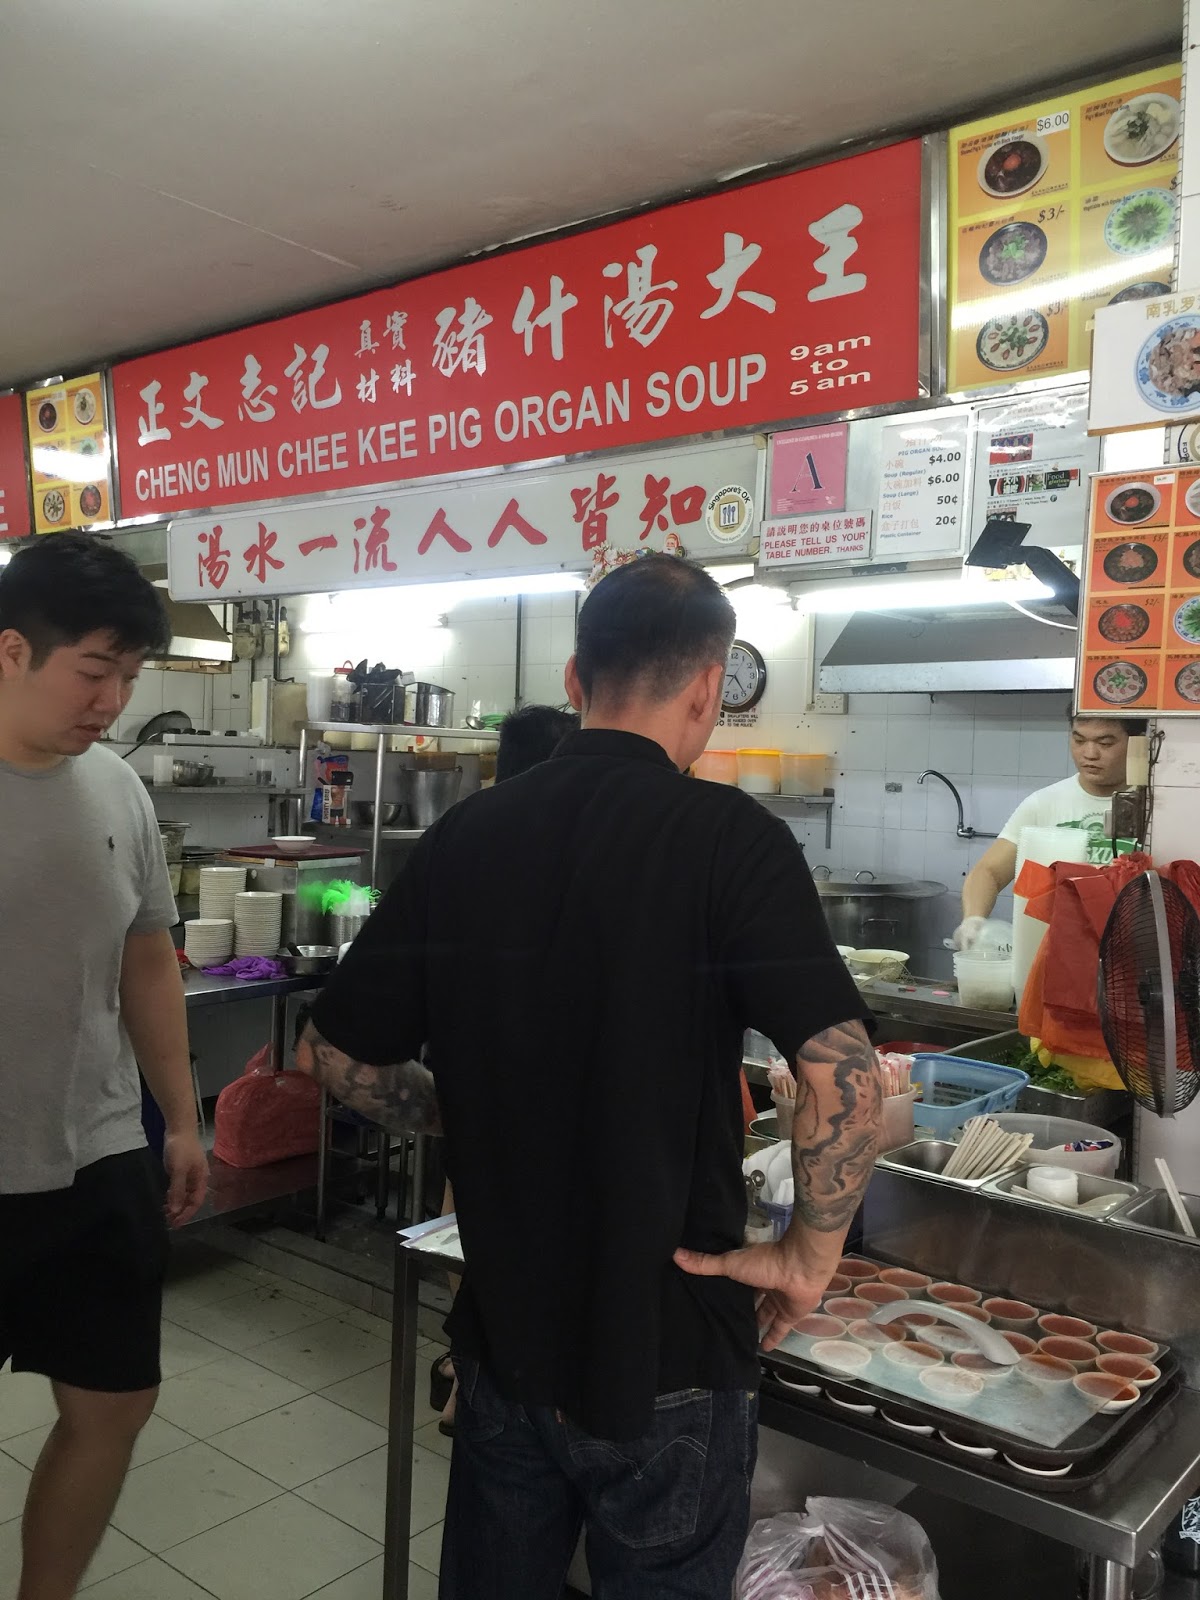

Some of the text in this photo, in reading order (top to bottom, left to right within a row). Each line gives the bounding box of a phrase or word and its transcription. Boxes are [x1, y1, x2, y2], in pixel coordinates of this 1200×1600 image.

[1037, 112, 1069, 132] $6.00
[1145, 295, 1200, 320] 南乳罗
[790, 335, 871, 361] 9am
[810, 358, 849, 375] to
[135, 353, 767, 501] CHENG MUN CHEE KEE PIG ORGAN SOUP
[910, 447, 931, 455] ORGAN
[929, 452, 961, 466] $4.00
[789, 451, 826, 494] A
[899, 469, 926, 477] (Regular)
[928, 473, 960, 486] $6.00
[1047, 472, 1065, 480] Food
[708, 486, 751, 511] Singapore's OK
[898, 490, 919, 498] (Large)
[937, 494, 958, 505] 50¢
[935, 516, 957, 526] 20¢
[764, 532, 866, 550] PLEASE TELL US YOUR
[765, 545, 864, 560] TABLE NUMBER. THANKS
